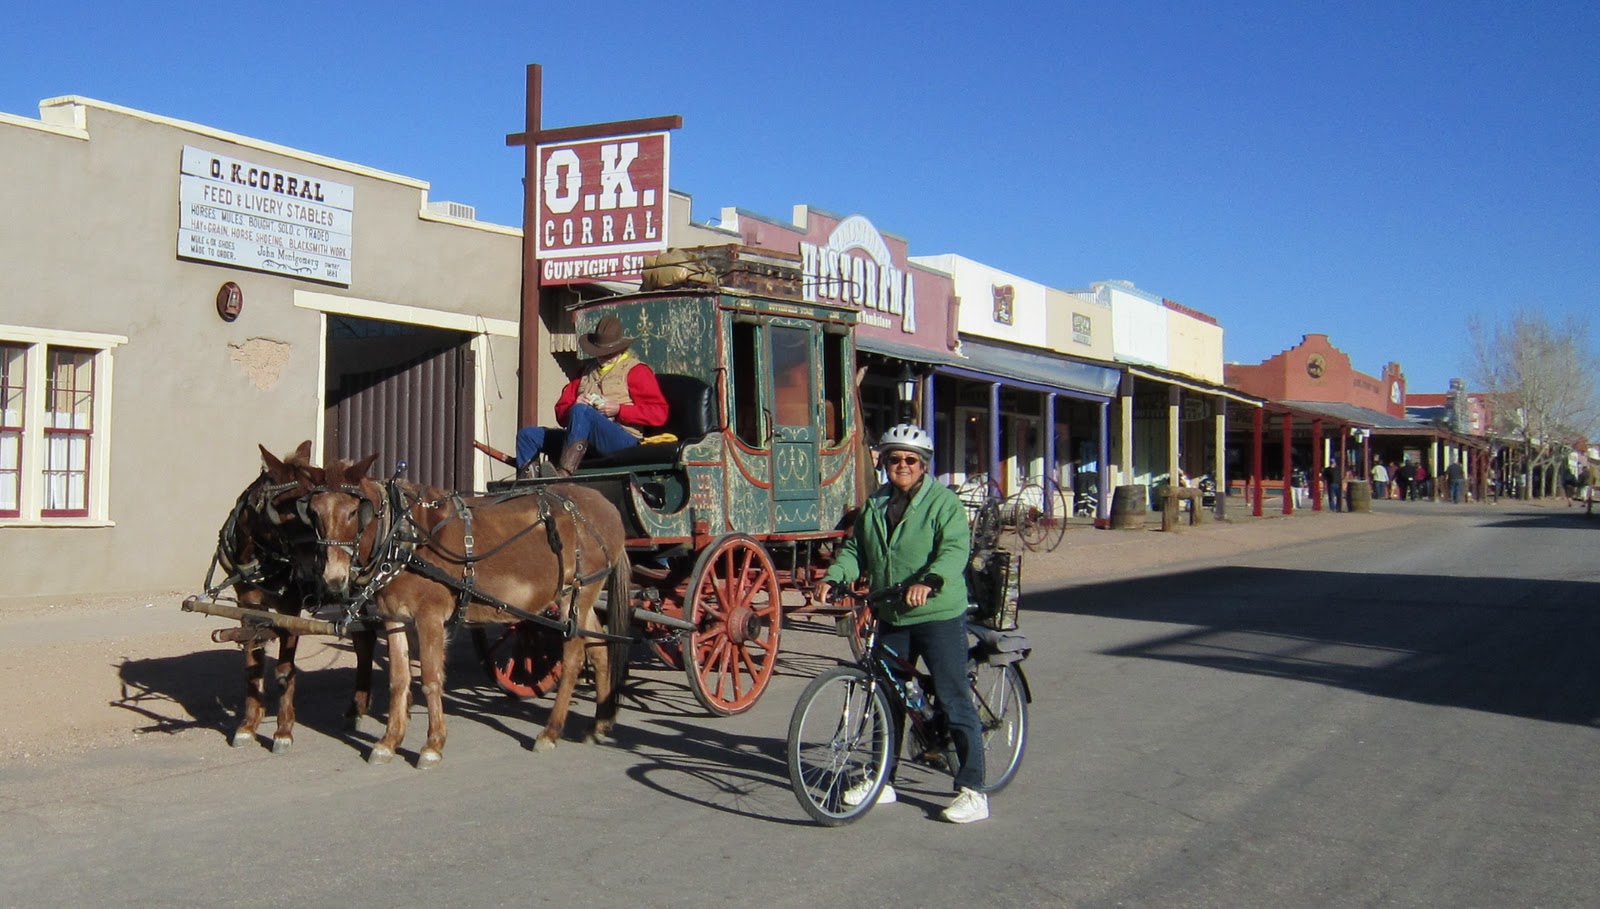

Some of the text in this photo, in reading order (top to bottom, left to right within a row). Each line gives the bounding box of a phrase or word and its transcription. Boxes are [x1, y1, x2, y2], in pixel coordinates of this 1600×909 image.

[544, 141, 655, 214] O.K.
[204, 185, 232, 205] FEED
[245, 194, 283, 216] LIVERY
[287, 203, 333, 227] STABLES
[304, 227, 329, 242] TRADED
[545, 211, 656, 247] CORRAL
[191, 234, 205, 244] MULE
[218, 239, 235, 250] SHOES
[191, 244, 205, 255] MADE
[208, 247, 214, 256] TO
[231, 228, 252, 241] HORSE
[289, 239, 327, 254] BLACKSMITH
[330, 246, 346, 257] WORK
[257, 245, 319, 270] John Montgomery
[544, 257, 619, 281] GUNFIGHT
